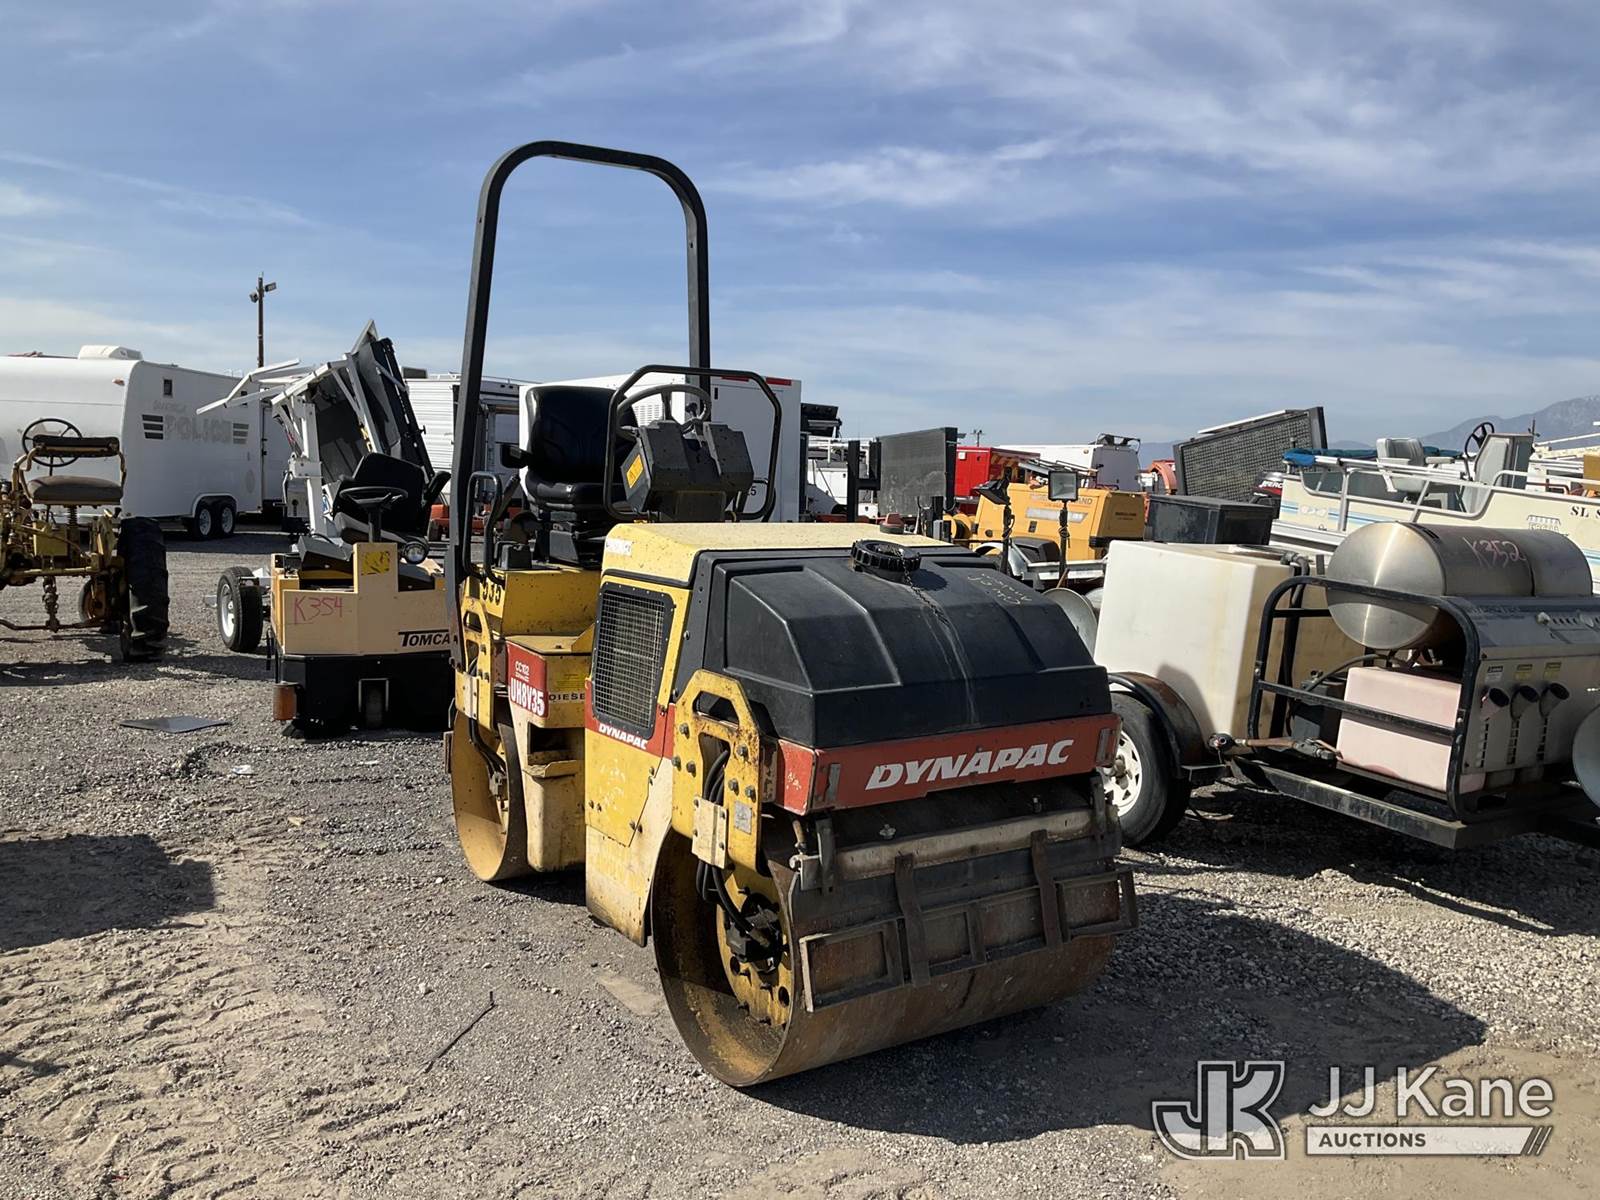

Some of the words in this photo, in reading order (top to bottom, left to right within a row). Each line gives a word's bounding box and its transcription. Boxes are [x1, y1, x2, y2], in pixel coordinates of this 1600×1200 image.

[1570, 505, 1589, 518] SL
[1462, 536, 1527, 569] K352
[294, 594, 344, 625] K354
[398, 629, 450, 647] TOMCA
[549, 692, 586, 702] DIESE
[598, 722, 649, 750] DYNAPAC
[865, 739, 1074, 791] DYNAPAC
